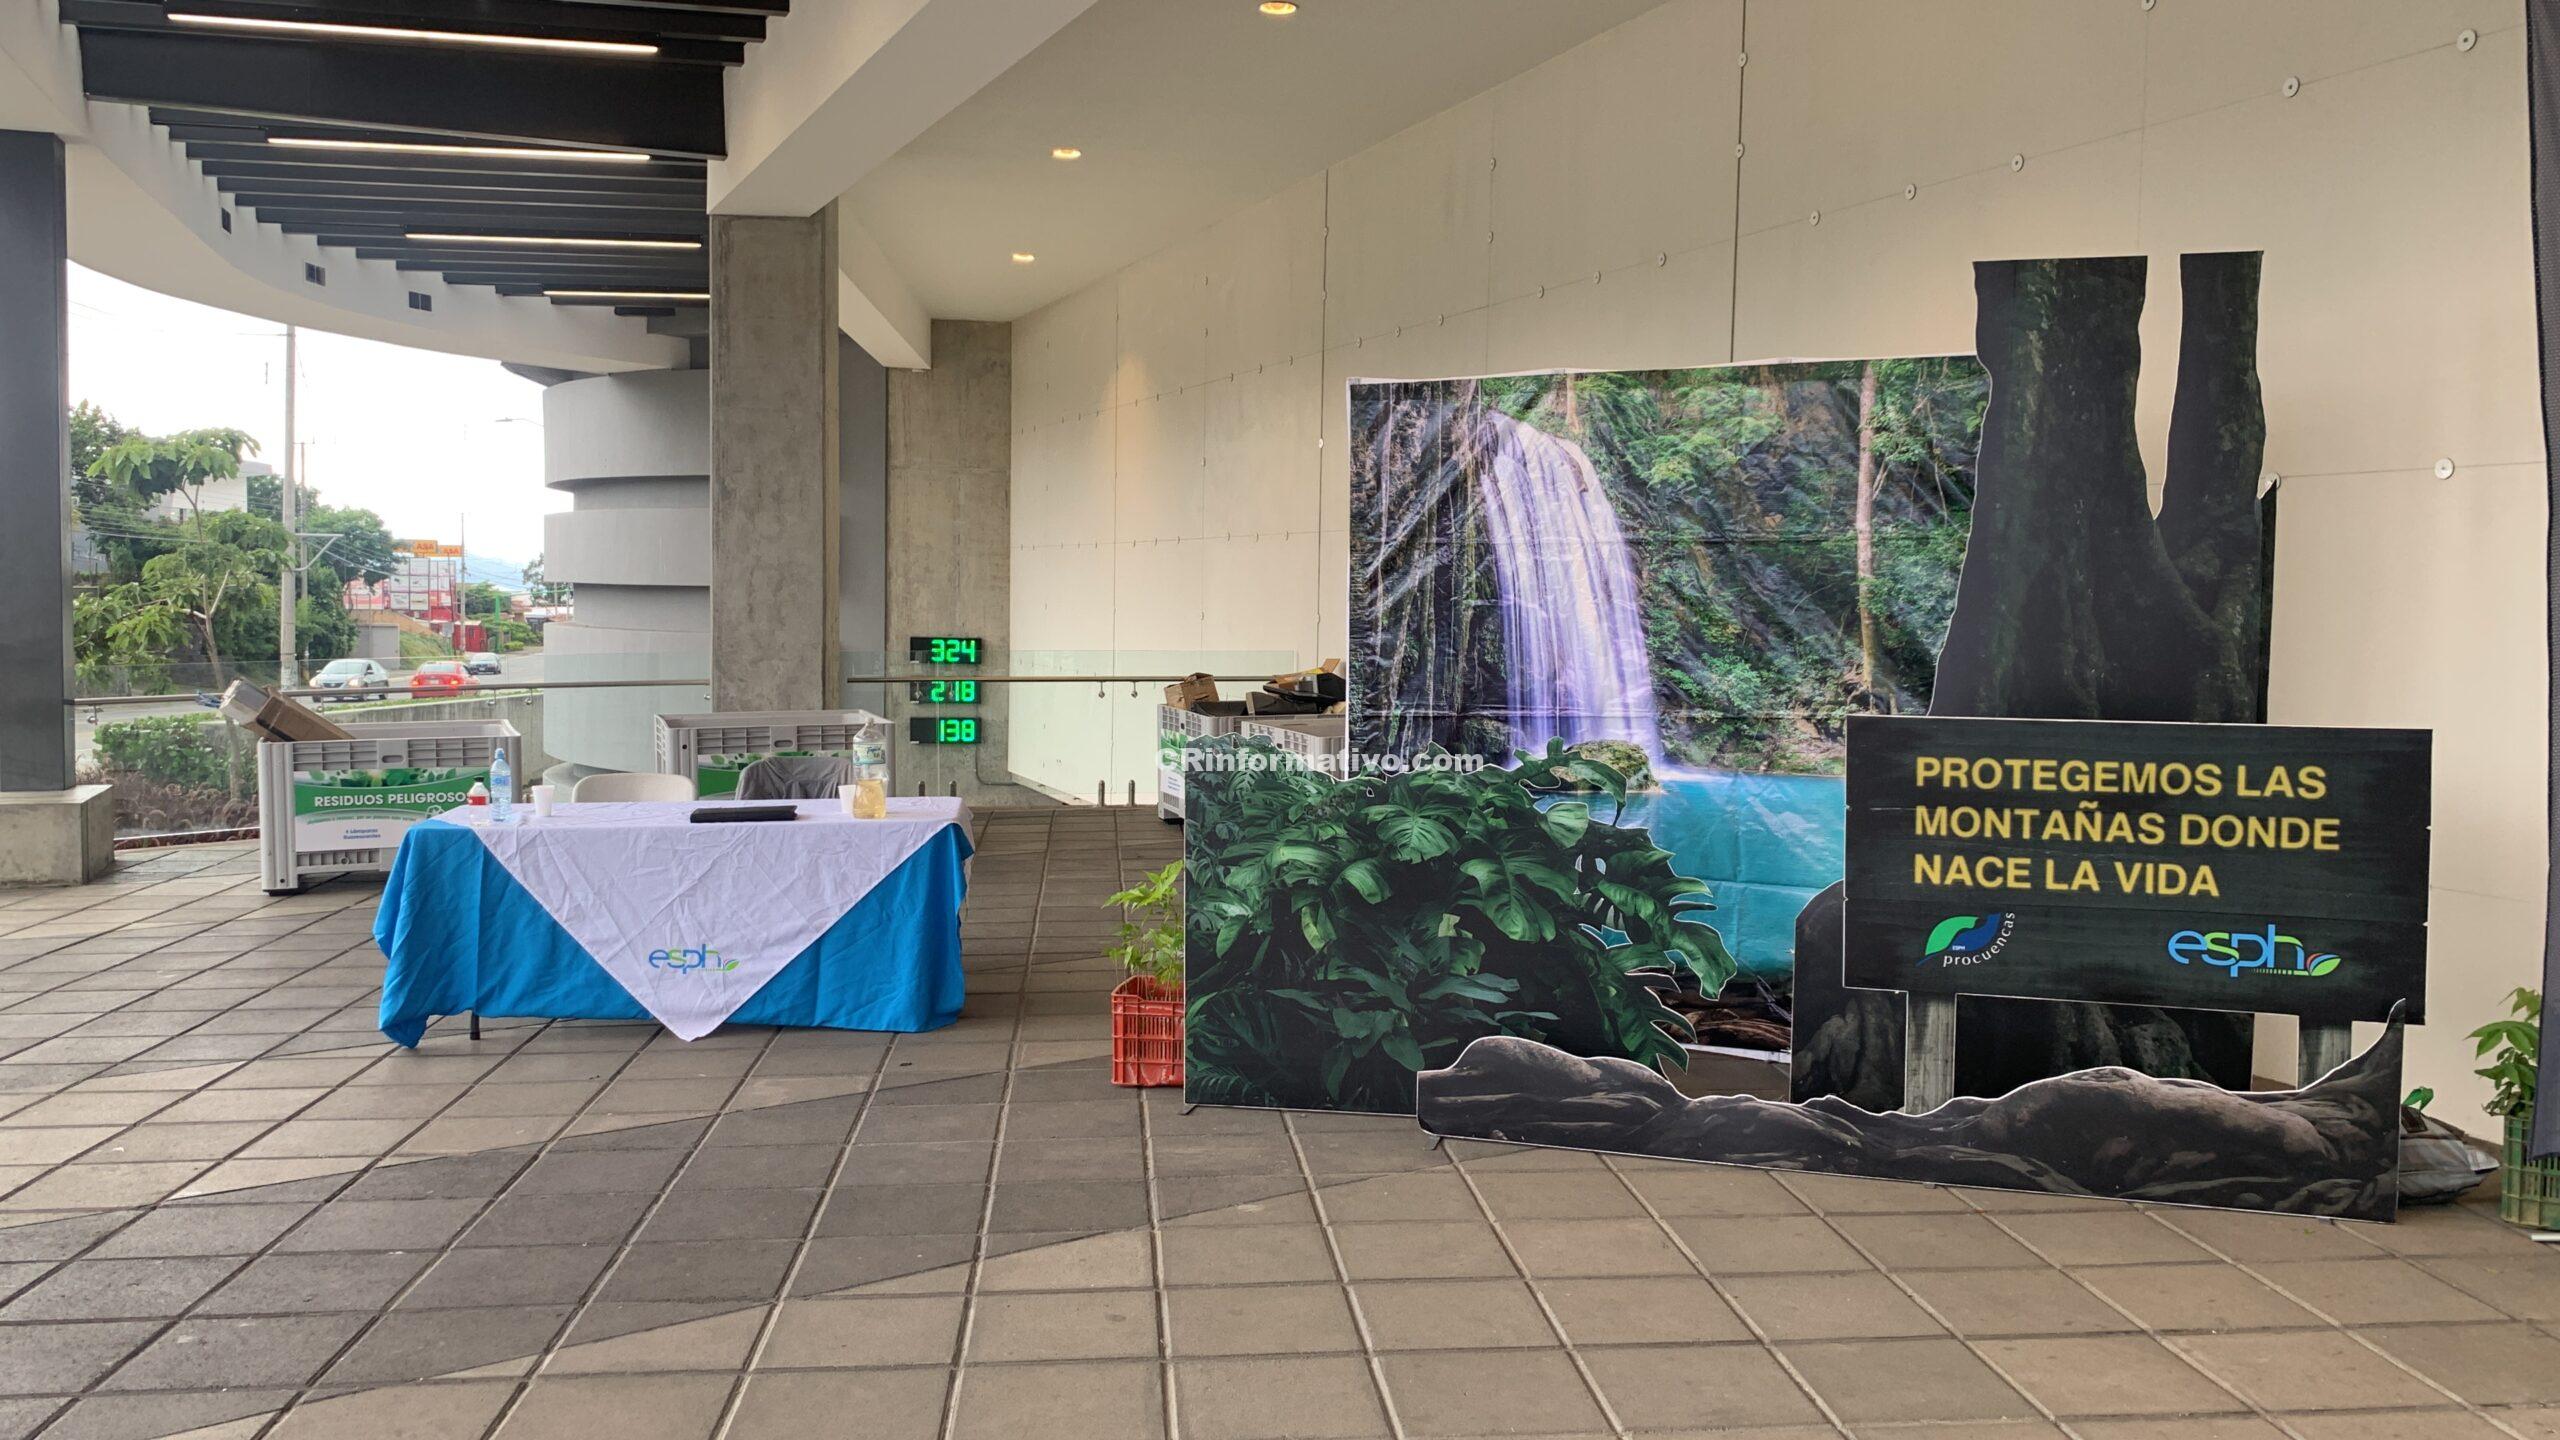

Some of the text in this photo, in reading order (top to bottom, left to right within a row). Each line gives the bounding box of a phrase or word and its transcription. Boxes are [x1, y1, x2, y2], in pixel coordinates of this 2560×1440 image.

[931, 639, 976, 662] 324
[931, 680, 975, 702] 218
[940, 719, 975, 742] 138
[1915, 756, 2327, 800] PROTEGEMOS LAS
[314, 790, 470, 807] RESIDUOS PELIGROSO
[1914, 800, 2341, 851] MONTAÑAS DONDE
[1913, 853, 2220, 896] NACE LA VIDA
[1943, 912, 2016, 968] procuencas
[2167, 923, 2305, 978] esph
[649, 943, 721, 975] esph
